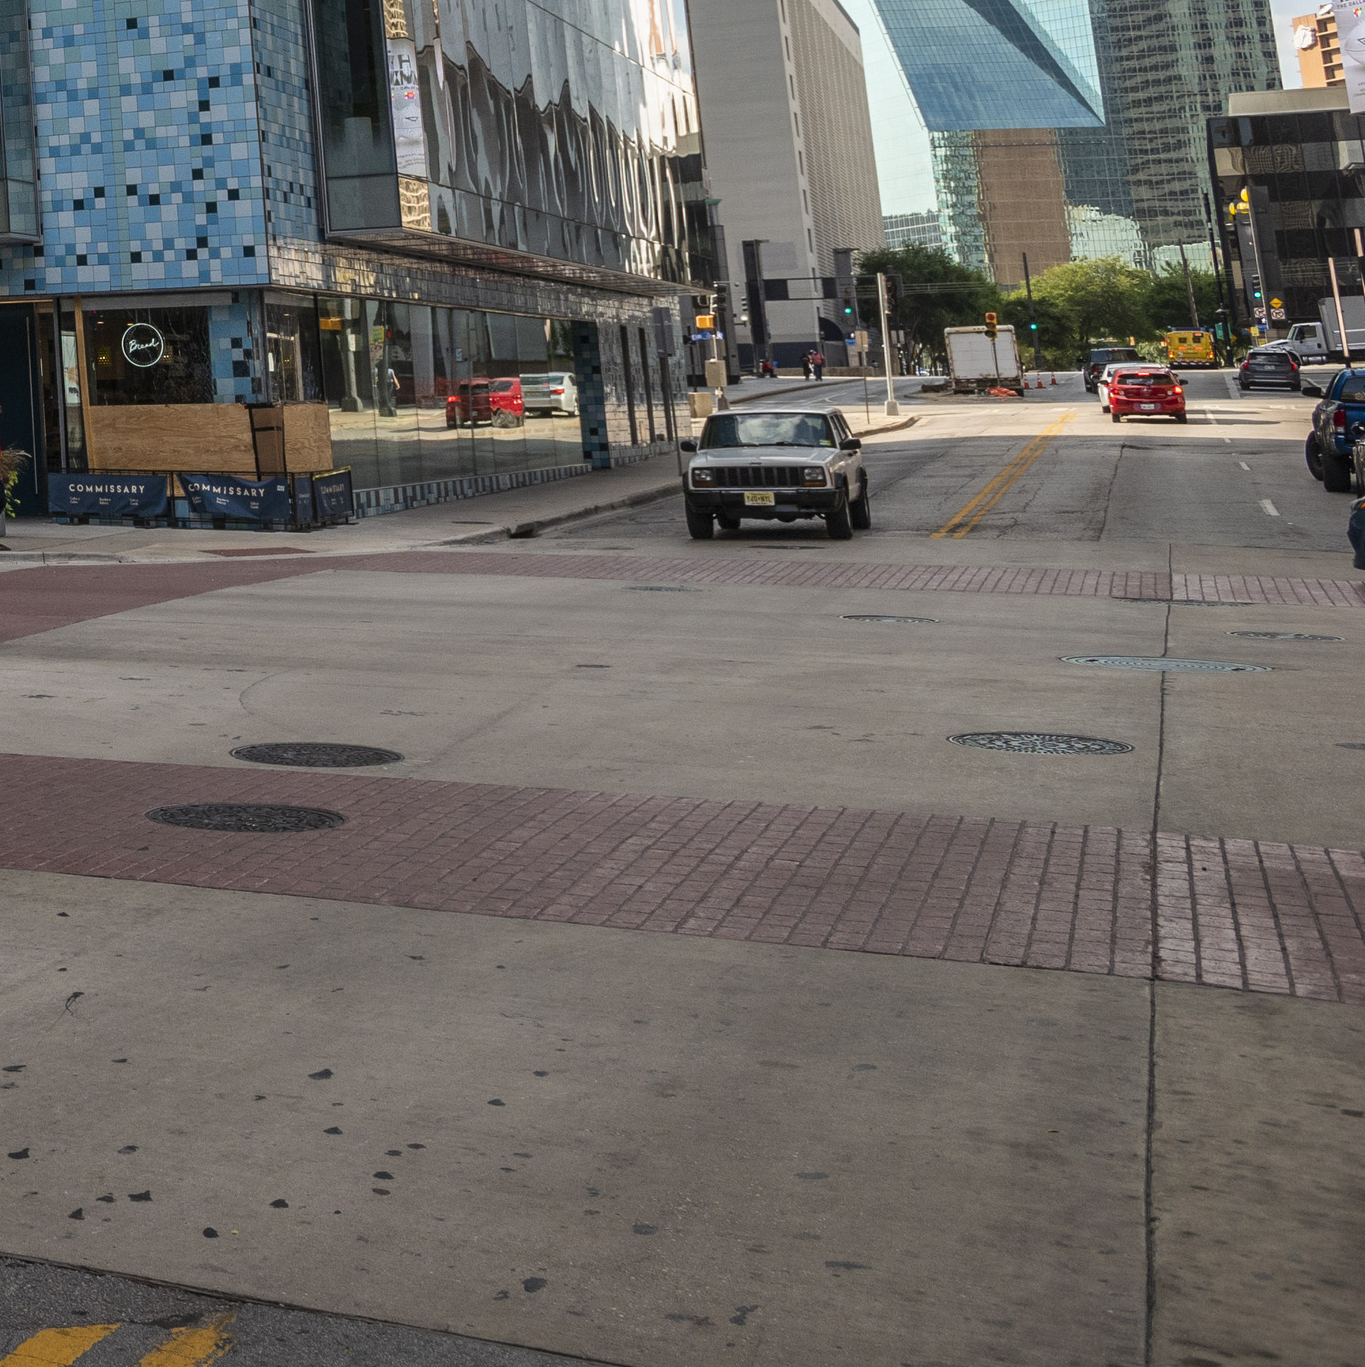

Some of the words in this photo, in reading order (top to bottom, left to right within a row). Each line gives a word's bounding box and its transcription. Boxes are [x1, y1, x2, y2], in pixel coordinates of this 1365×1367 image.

[129, 338, 160, 353] Bread
[68, 483, 145, 494] COMMISSARY
[187, 482, 266, 497] COMMISSARY
